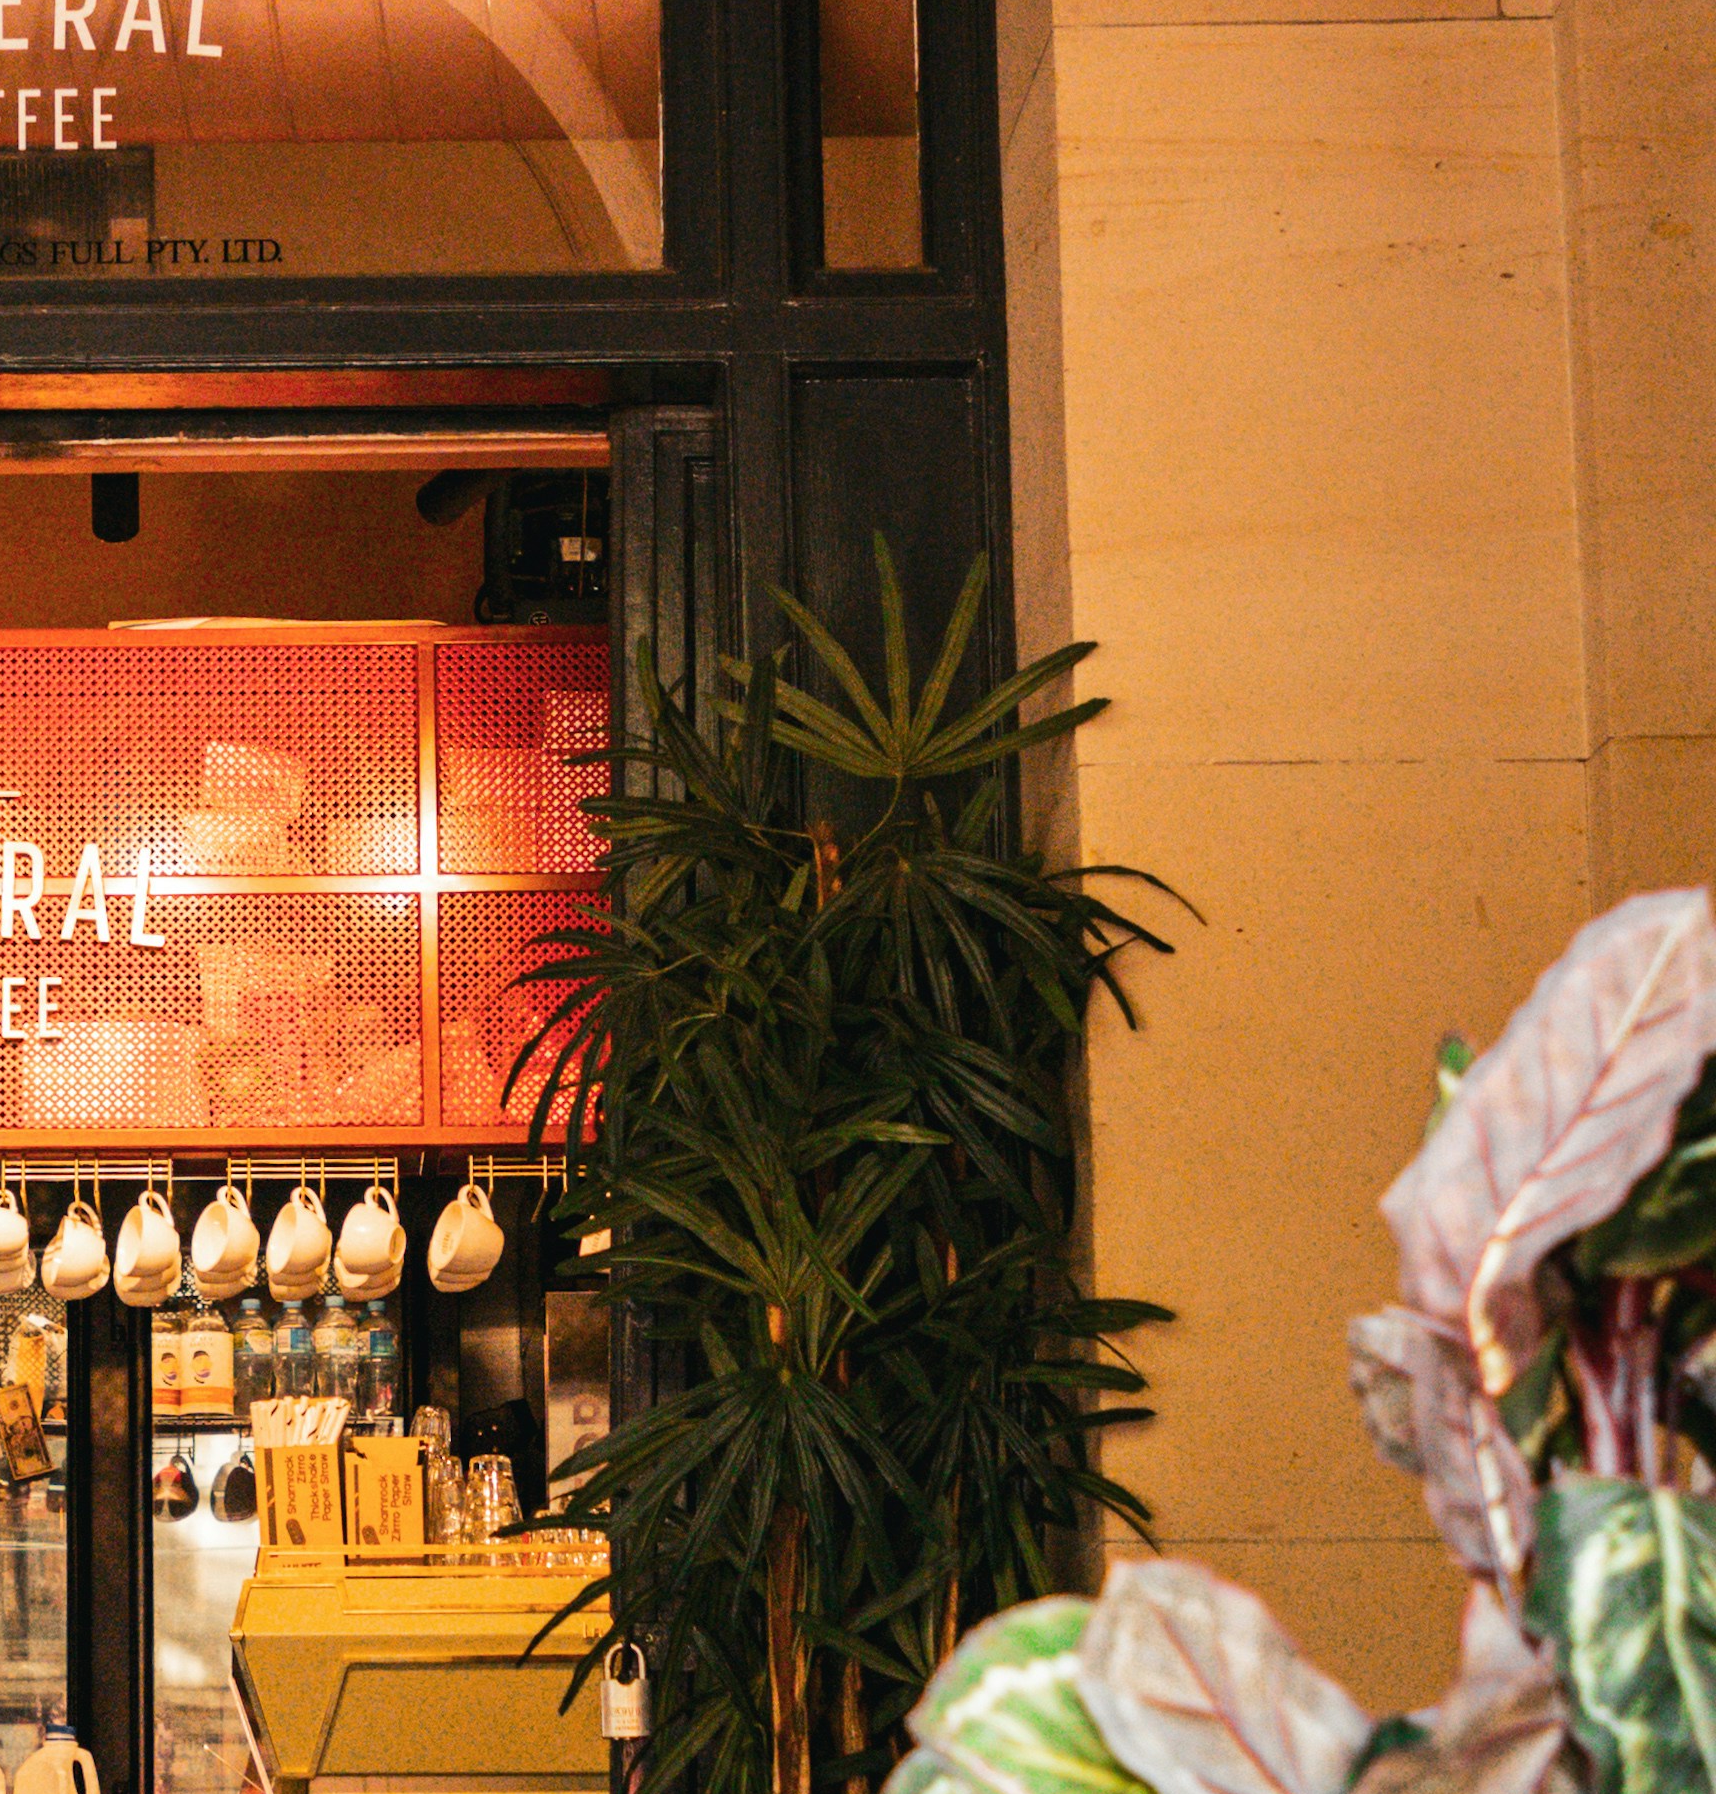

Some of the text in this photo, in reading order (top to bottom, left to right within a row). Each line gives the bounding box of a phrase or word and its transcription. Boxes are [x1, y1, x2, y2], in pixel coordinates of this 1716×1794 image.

[51, 240, 135, 265] FULL
[145, 239, 210, 265] PTY.
[221, 238, 284, 264] LTD.
[284, 1455, 297, 1515] Shamrock
[309, 1453, 320, 1522] Thickshake
[320, 1453, 332, 1522] Paper Straw
[378, 1474, 389, 1536] Shamrock
[390, 1473, 402, 1509] Paper
[402, 1474, 413, 1506] Straw
